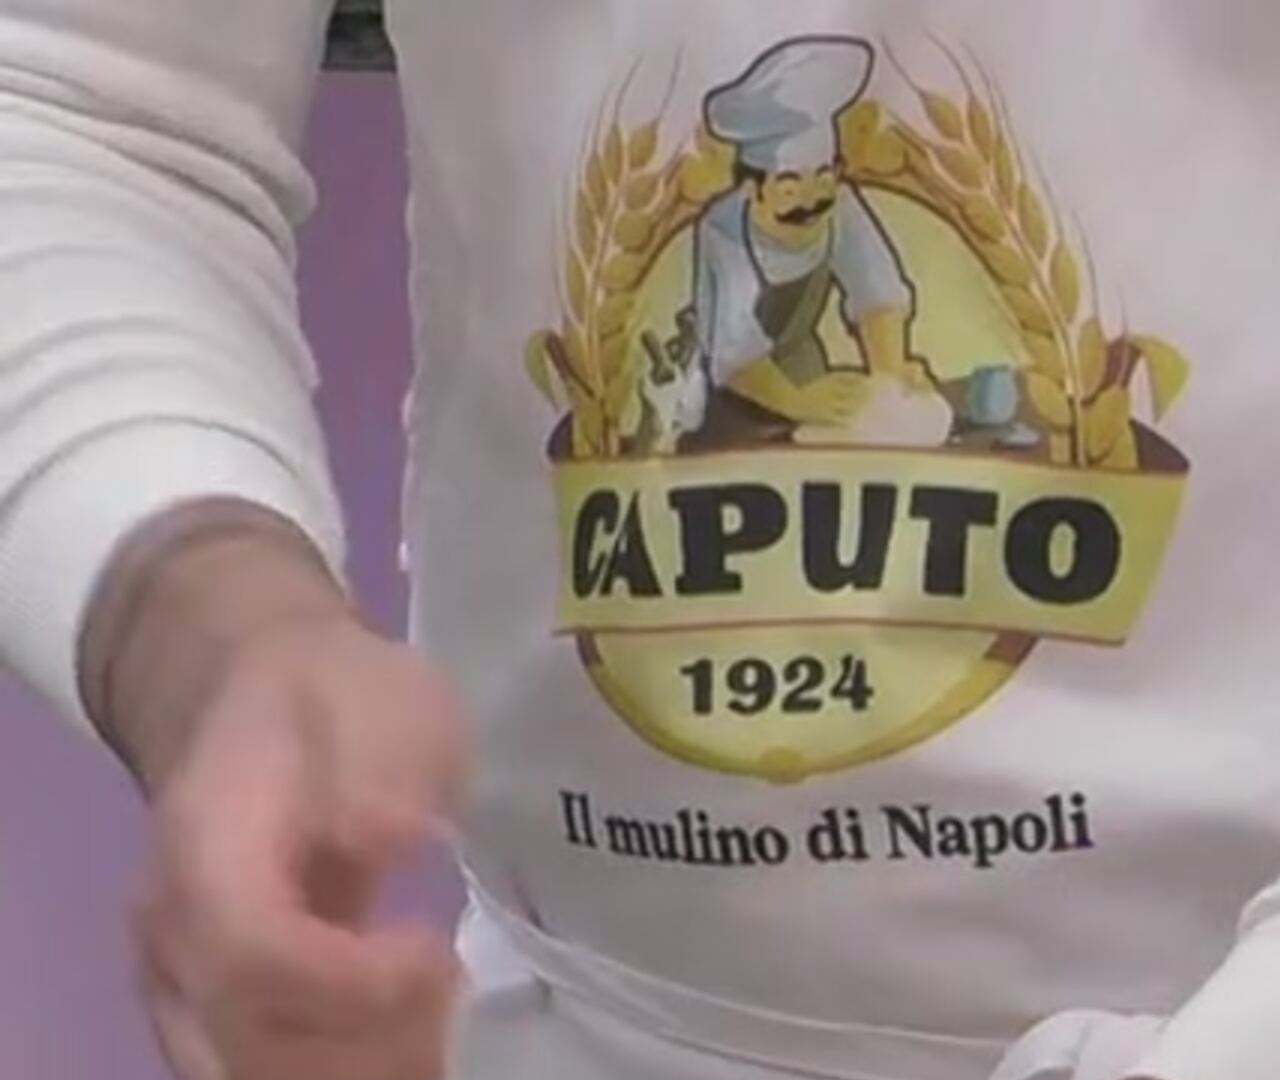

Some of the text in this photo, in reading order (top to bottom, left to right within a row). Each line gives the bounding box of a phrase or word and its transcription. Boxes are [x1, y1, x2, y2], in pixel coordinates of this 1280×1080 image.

[571, 481, 1122, 605] CAPUTO
[680, 653, 874, 715] 1924
[559, 789, 1094, 868] Il mulino di Napoli
